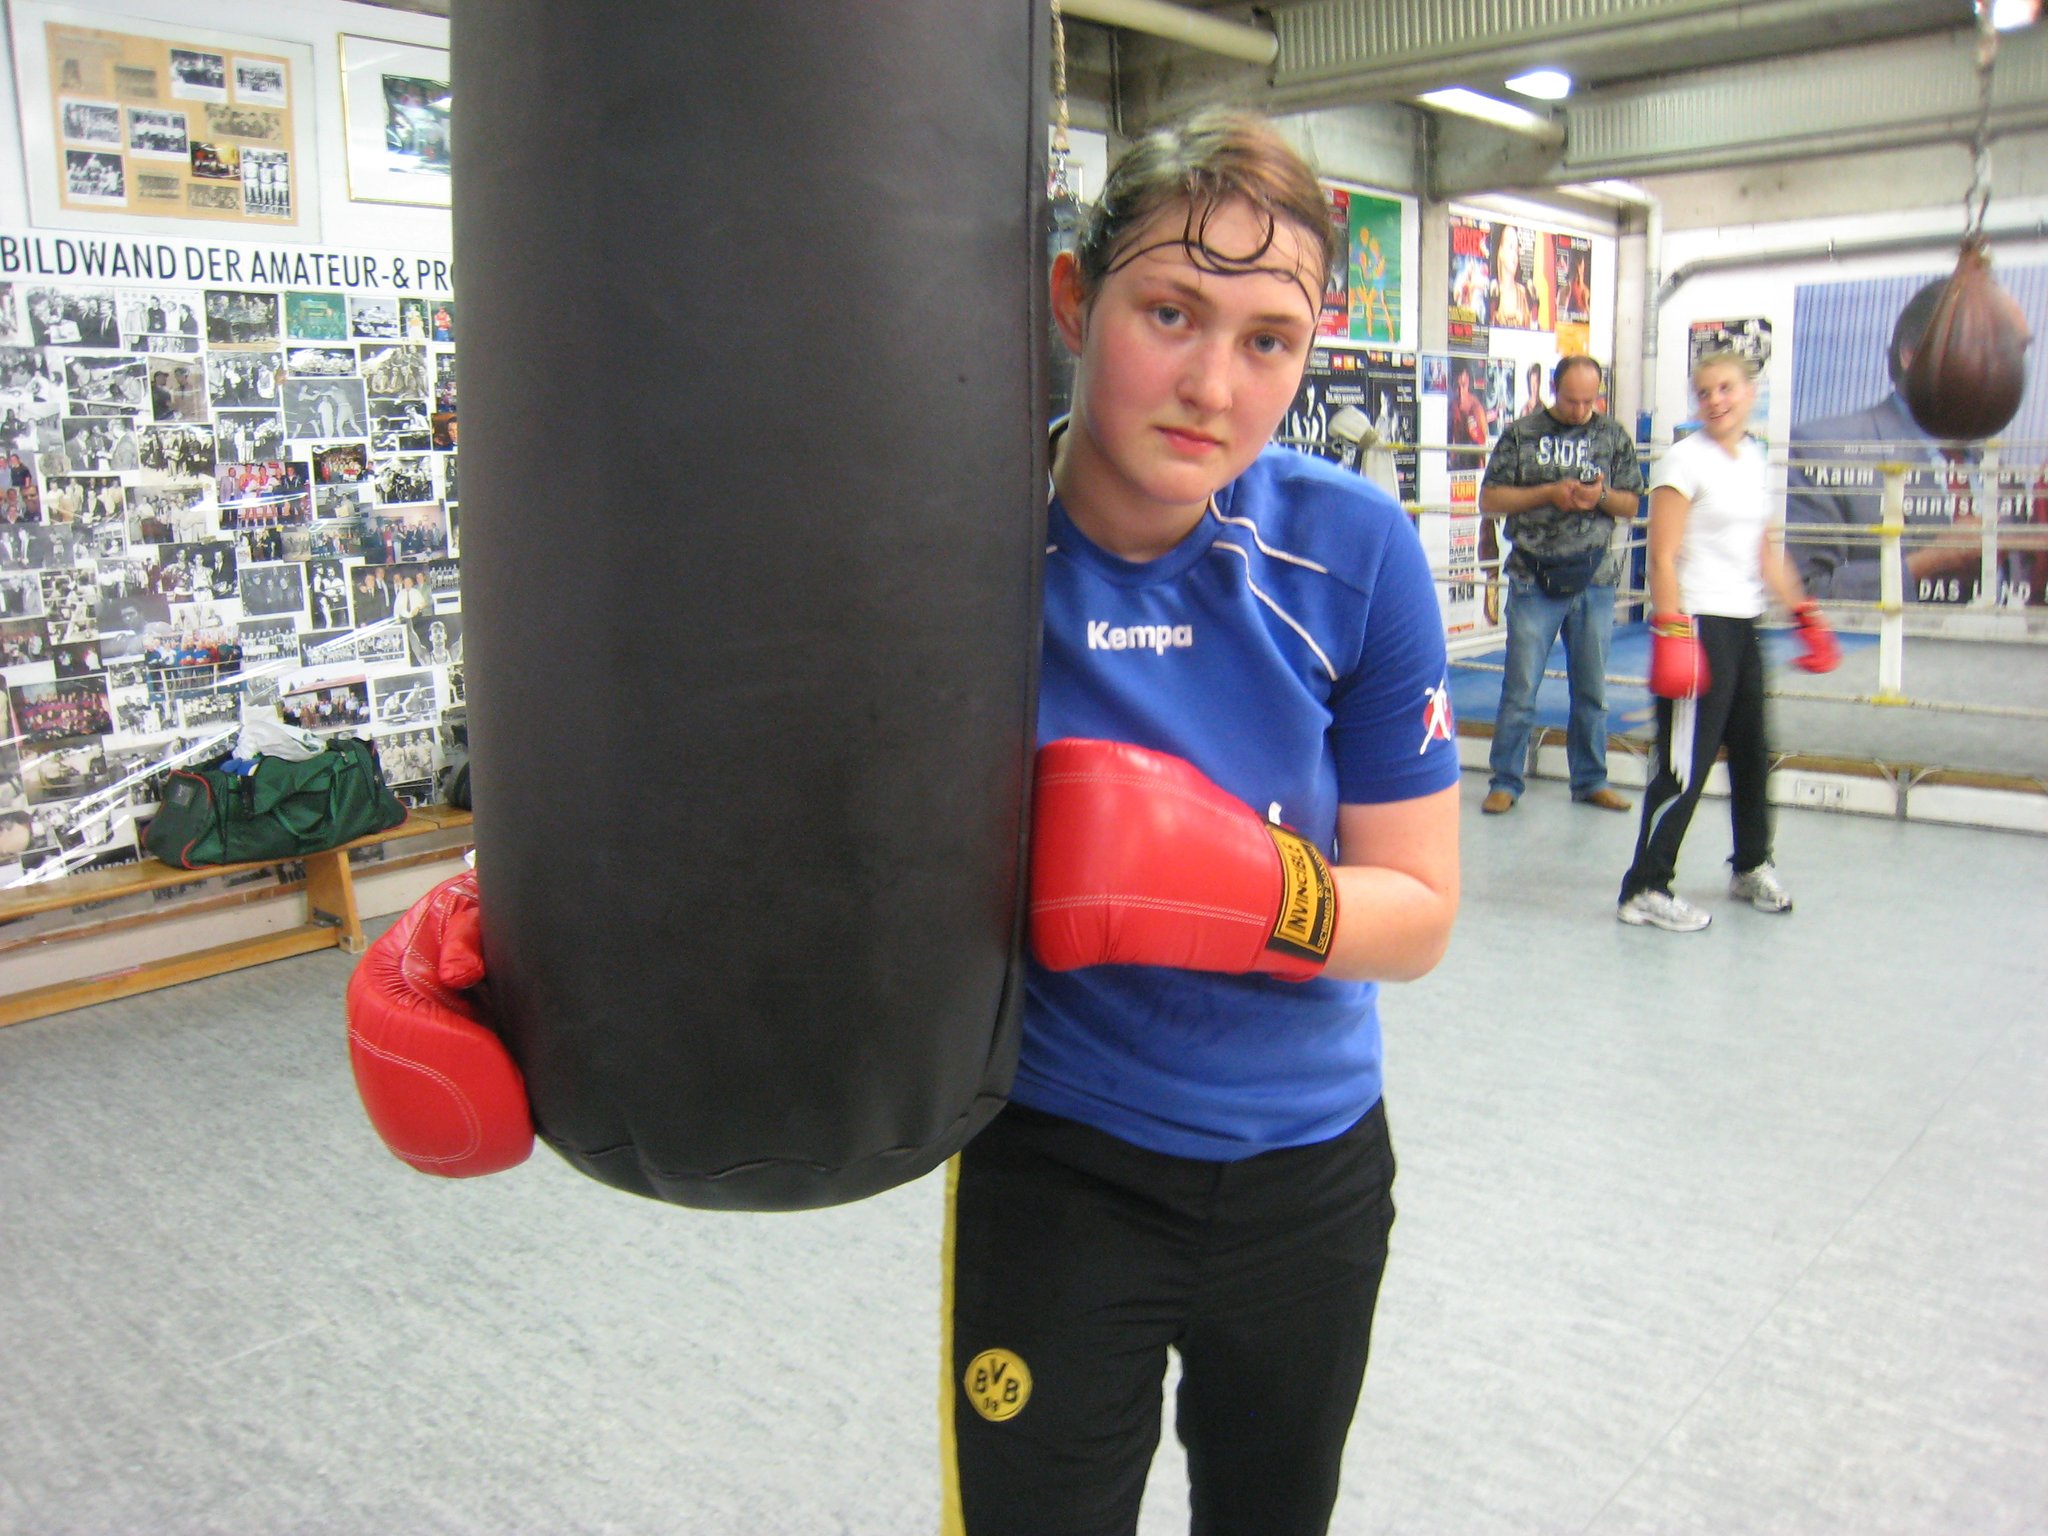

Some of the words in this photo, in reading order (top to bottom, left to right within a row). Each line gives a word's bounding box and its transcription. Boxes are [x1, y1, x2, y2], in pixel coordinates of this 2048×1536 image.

[0, 235, 177, 279] BILDWAND
[185, 246, 242, 282] DER
[417, 259, 454, 291] PR
[1919, 578, 1961, 602] DAS
[1087, 620, 1193, 656] Kempa
